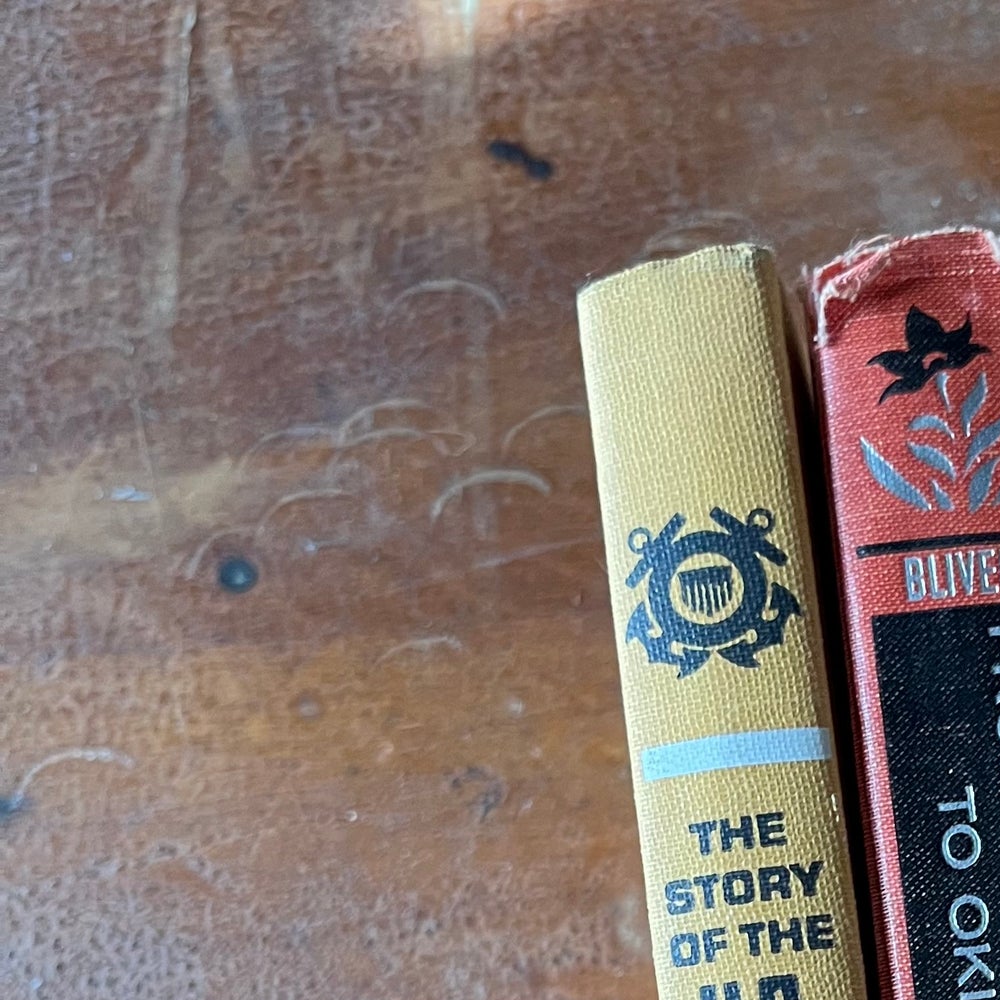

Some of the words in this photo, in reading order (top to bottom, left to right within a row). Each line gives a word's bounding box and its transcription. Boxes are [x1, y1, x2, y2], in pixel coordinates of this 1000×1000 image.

[688, 812, 787, 856] THE
[937, 785, 982, 870] TO
[665, 861, 824, 915] STORY
[670, 927, 728, 967] OF
[738, 914, 834, 958] THE
